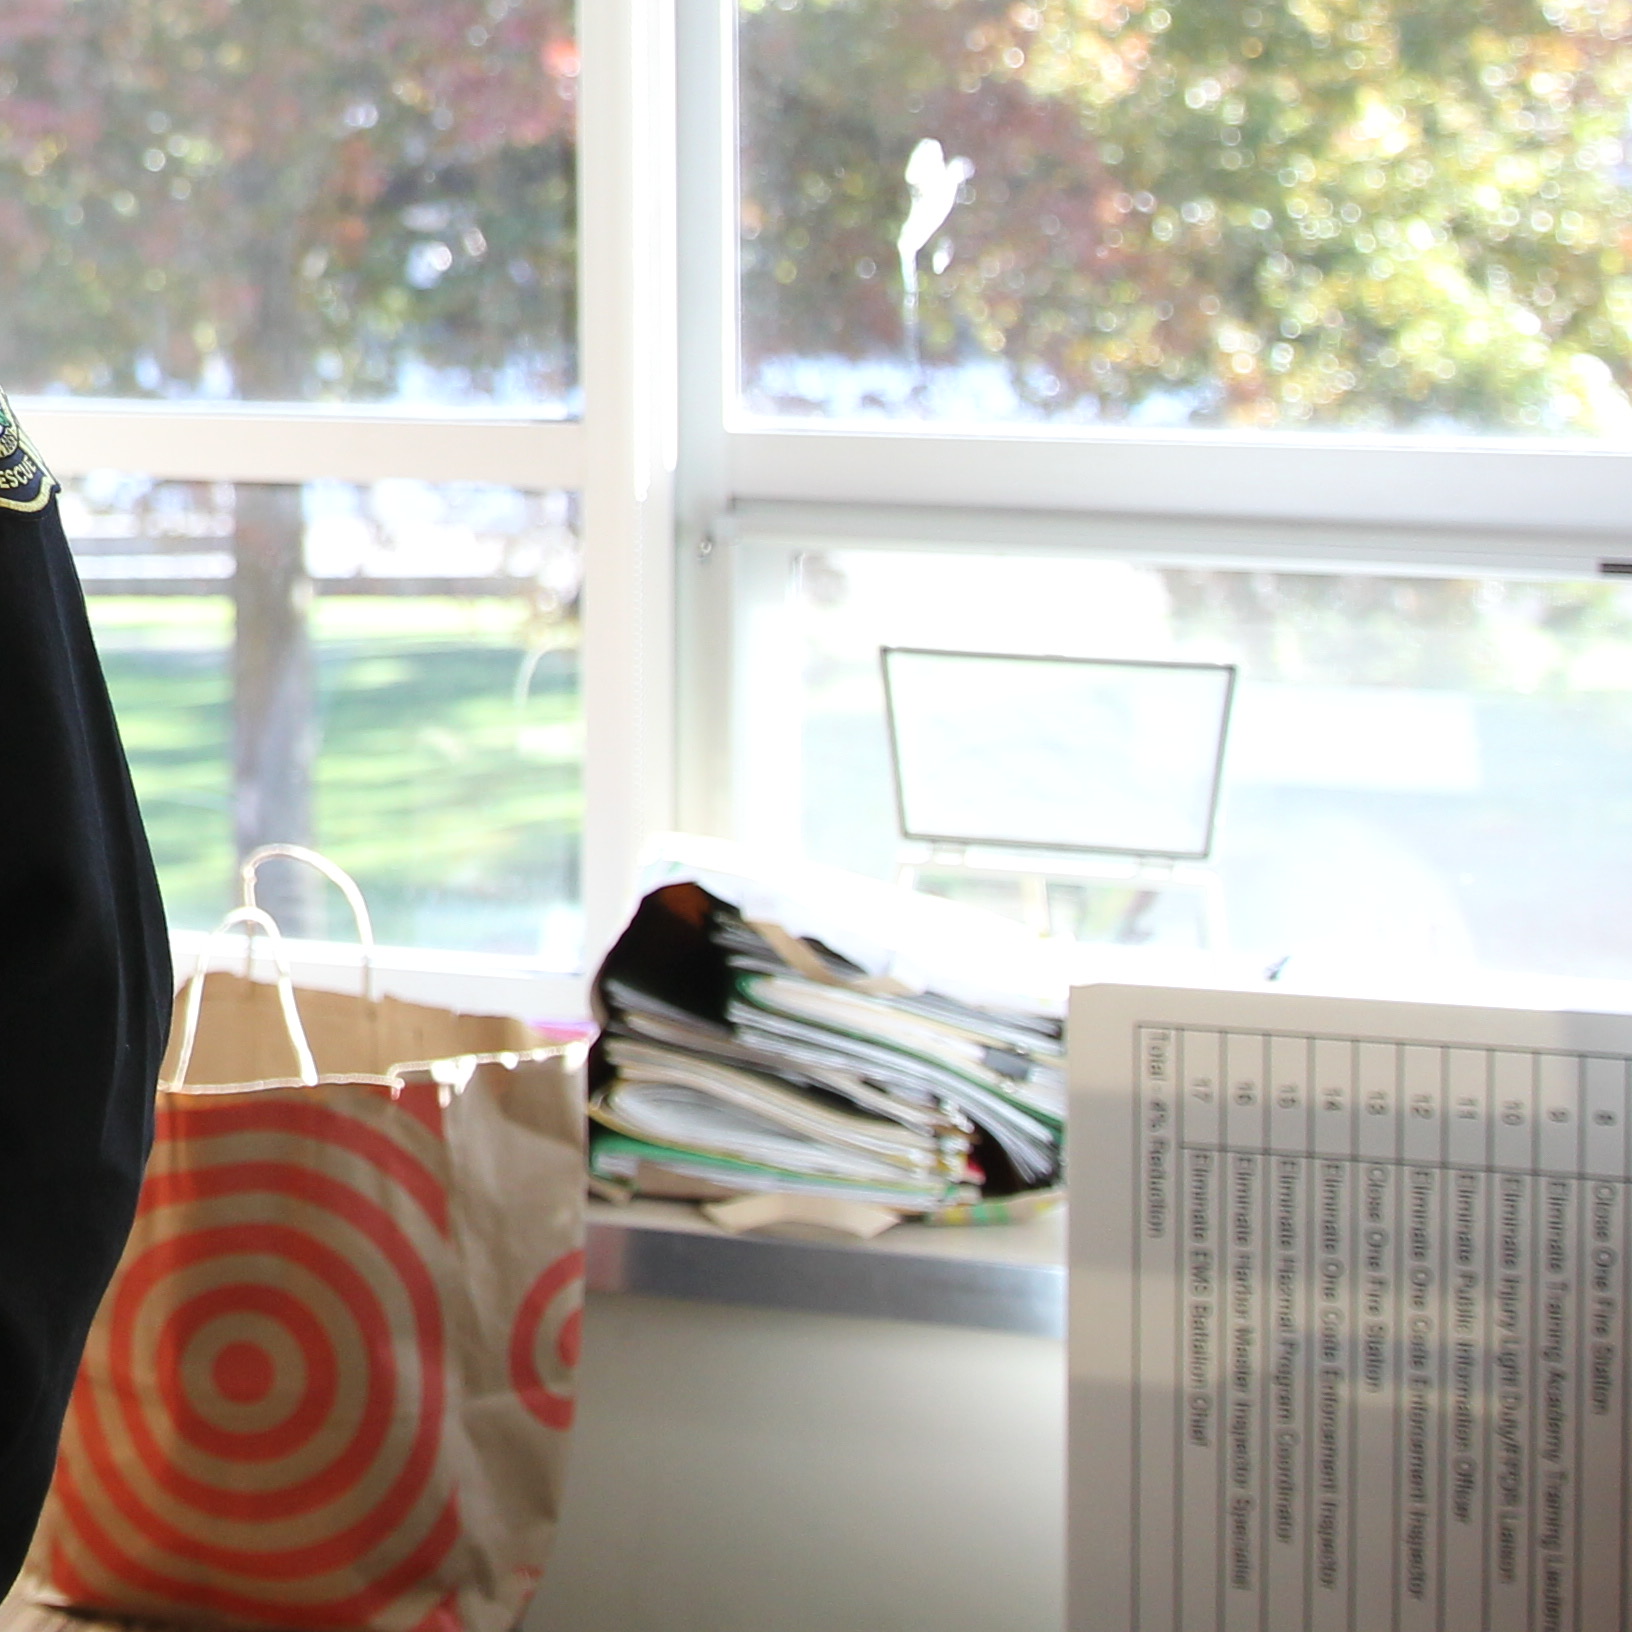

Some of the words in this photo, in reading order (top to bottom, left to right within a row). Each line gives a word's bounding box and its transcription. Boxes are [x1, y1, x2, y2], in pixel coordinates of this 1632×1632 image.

[1148, 1031, 1171, 1081] Total
[1190, 1077, 1214, 1104] 17
[1322, 1086, 1345, 1111] 14
[1411, 1094, 1434, 1120] 12
[1456, 1096, 1479, 1120] 11
[1502, 1100, 1526, 1126] 10
[1147, 1135, 1171, 1238] Reduction
[1189, 1152, 1215, 1244] Eliminate
[1233, 1156, 1258, 1248] Eliminate
[1275, 1159, 1301, 1252] Eliminate
[1321, 1162, 1346, 1255] Eliminate
[1365, 1166, 1390, 1223] Close
[1410, 1169, 1434, 1262] Eliminate
[1592, 1183, 1618, 1242] Close
[1365, 1227, 1390, 1272] One
[1455, 1174, 1480, 1266] Eliminate
[1502, 1176, 1526, 1270] Eliminate
[1546, 1180, 1572, 1274] Eliminate
[1320, 1258, 1346, 1303] One
[1365, 1276, 1390, 1317] Fire
[1410, 1265, 1436, 1311] One
[1592, 1246, 1618, 1292] One
[1454, 1270, 1479, 1335] Public
[1540, 1278, 1570, 1362] Training
[1592, 1297, 1618, 1338] Fire
[1272, 1338, 1298, 1425] Program
[1364, 1322, 1390, 1393] Station
[1590, 1342, 1616, 1416] Station
[1188, 1392, 1214, 1448] Chief
